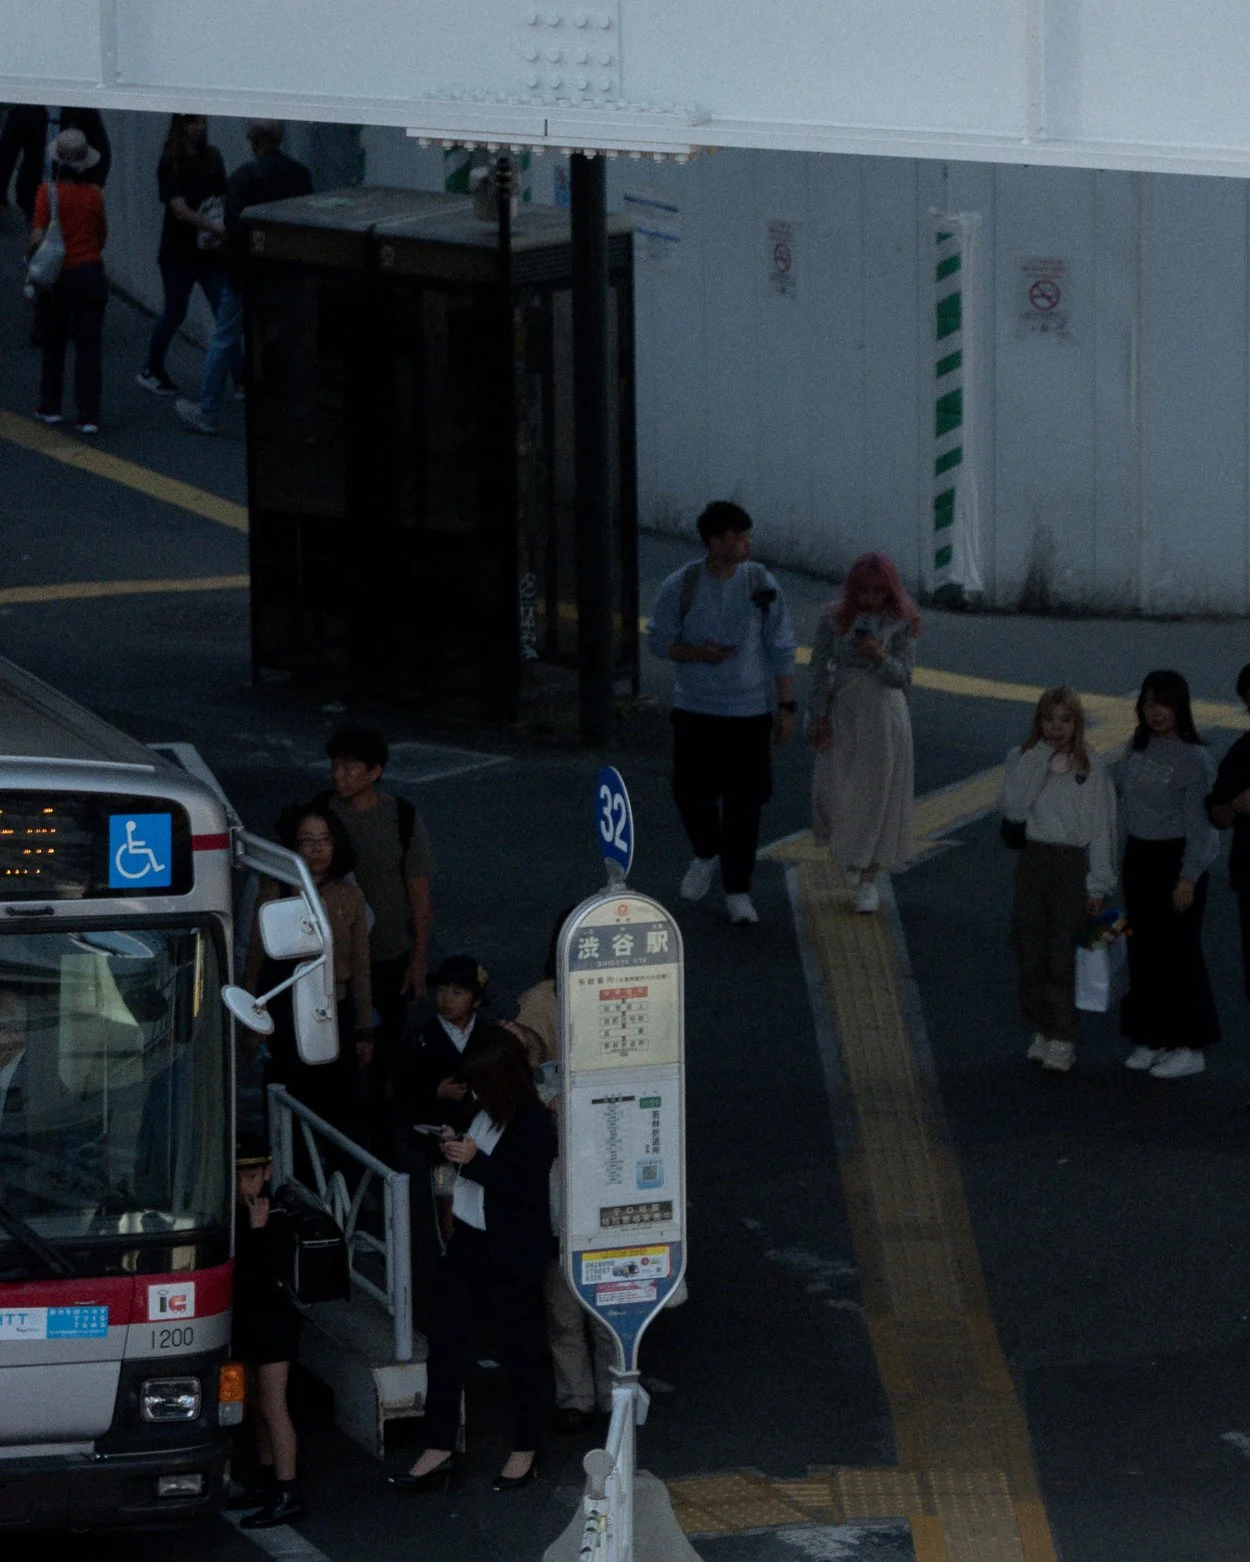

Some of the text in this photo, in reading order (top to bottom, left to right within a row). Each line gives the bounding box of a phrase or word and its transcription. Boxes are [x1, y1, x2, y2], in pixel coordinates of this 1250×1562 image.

[600, 784, 628, 853] 32
[577, 930, 669, 960] 渋谷駅
[151, 1326, 194, 1349] 1200
